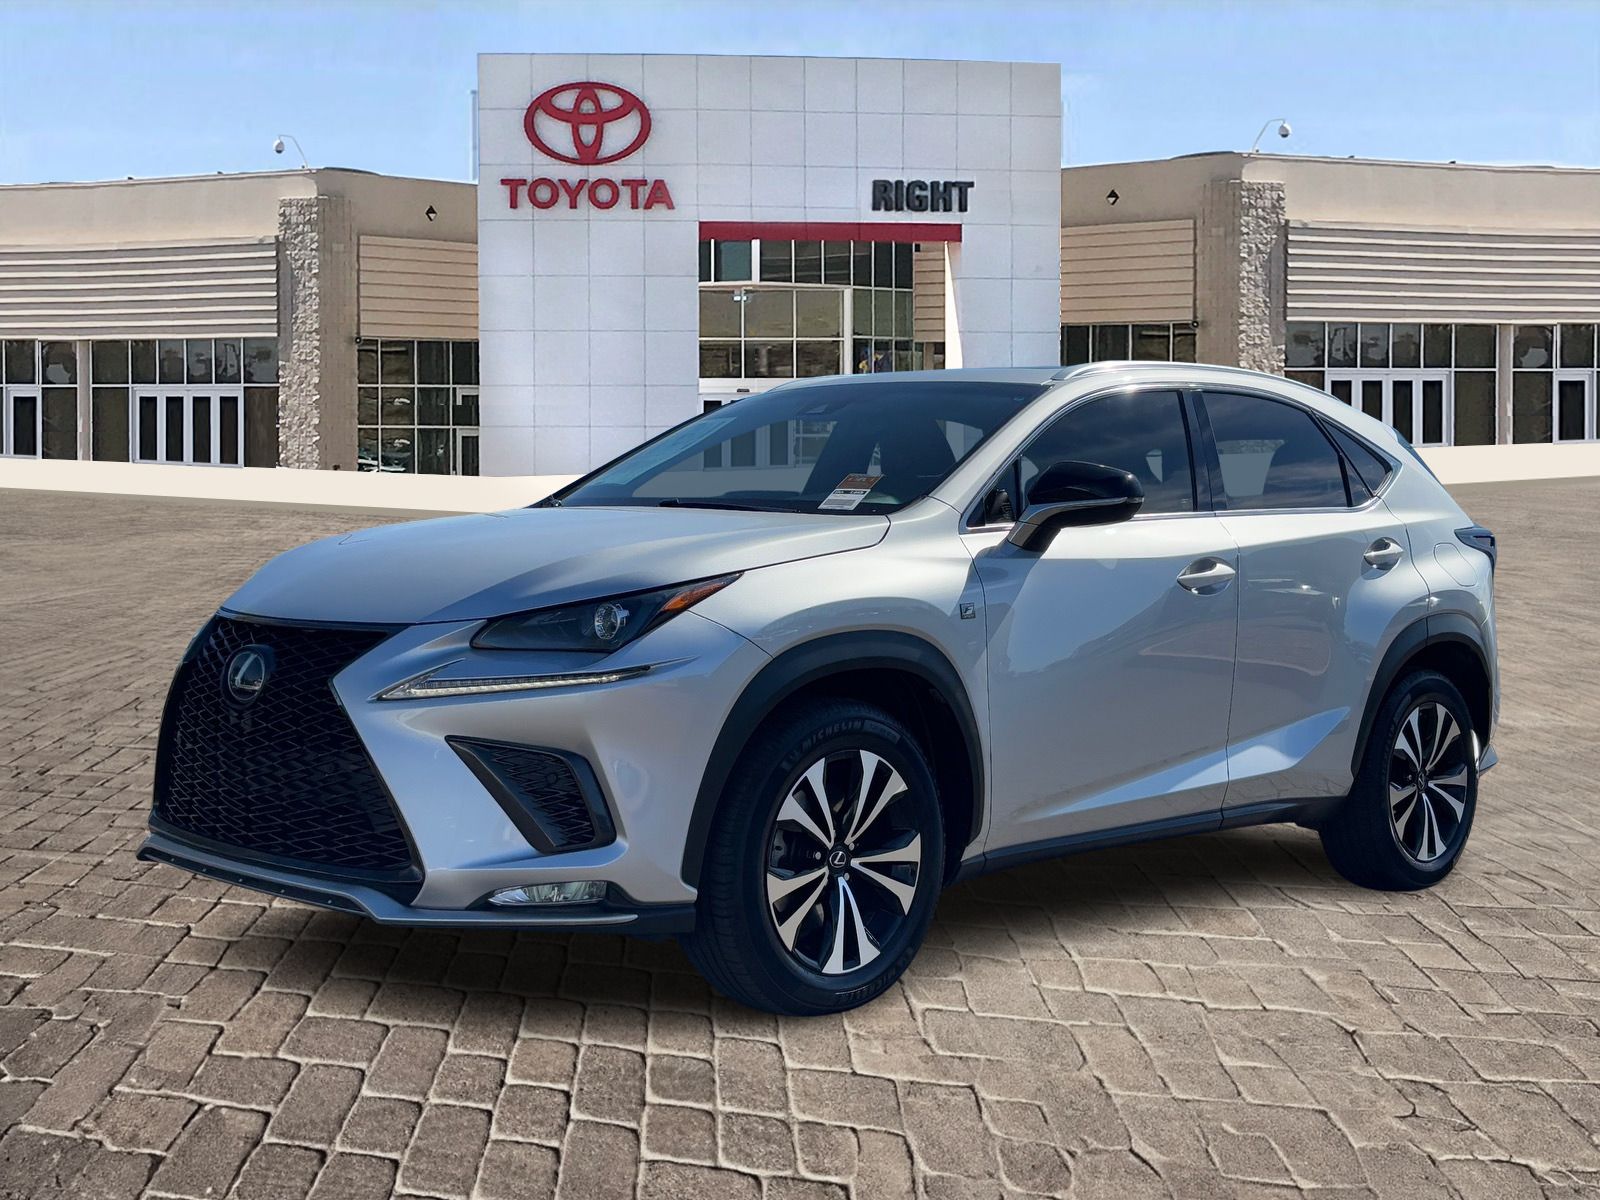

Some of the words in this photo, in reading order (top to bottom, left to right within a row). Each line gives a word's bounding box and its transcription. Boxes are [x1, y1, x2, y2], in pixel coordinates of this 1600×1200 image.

[500, 178, 675, 210] TOYOTA
[871, 179, 975, 212] RIGHT
[801, 719, 864, 751] MICHELIN
